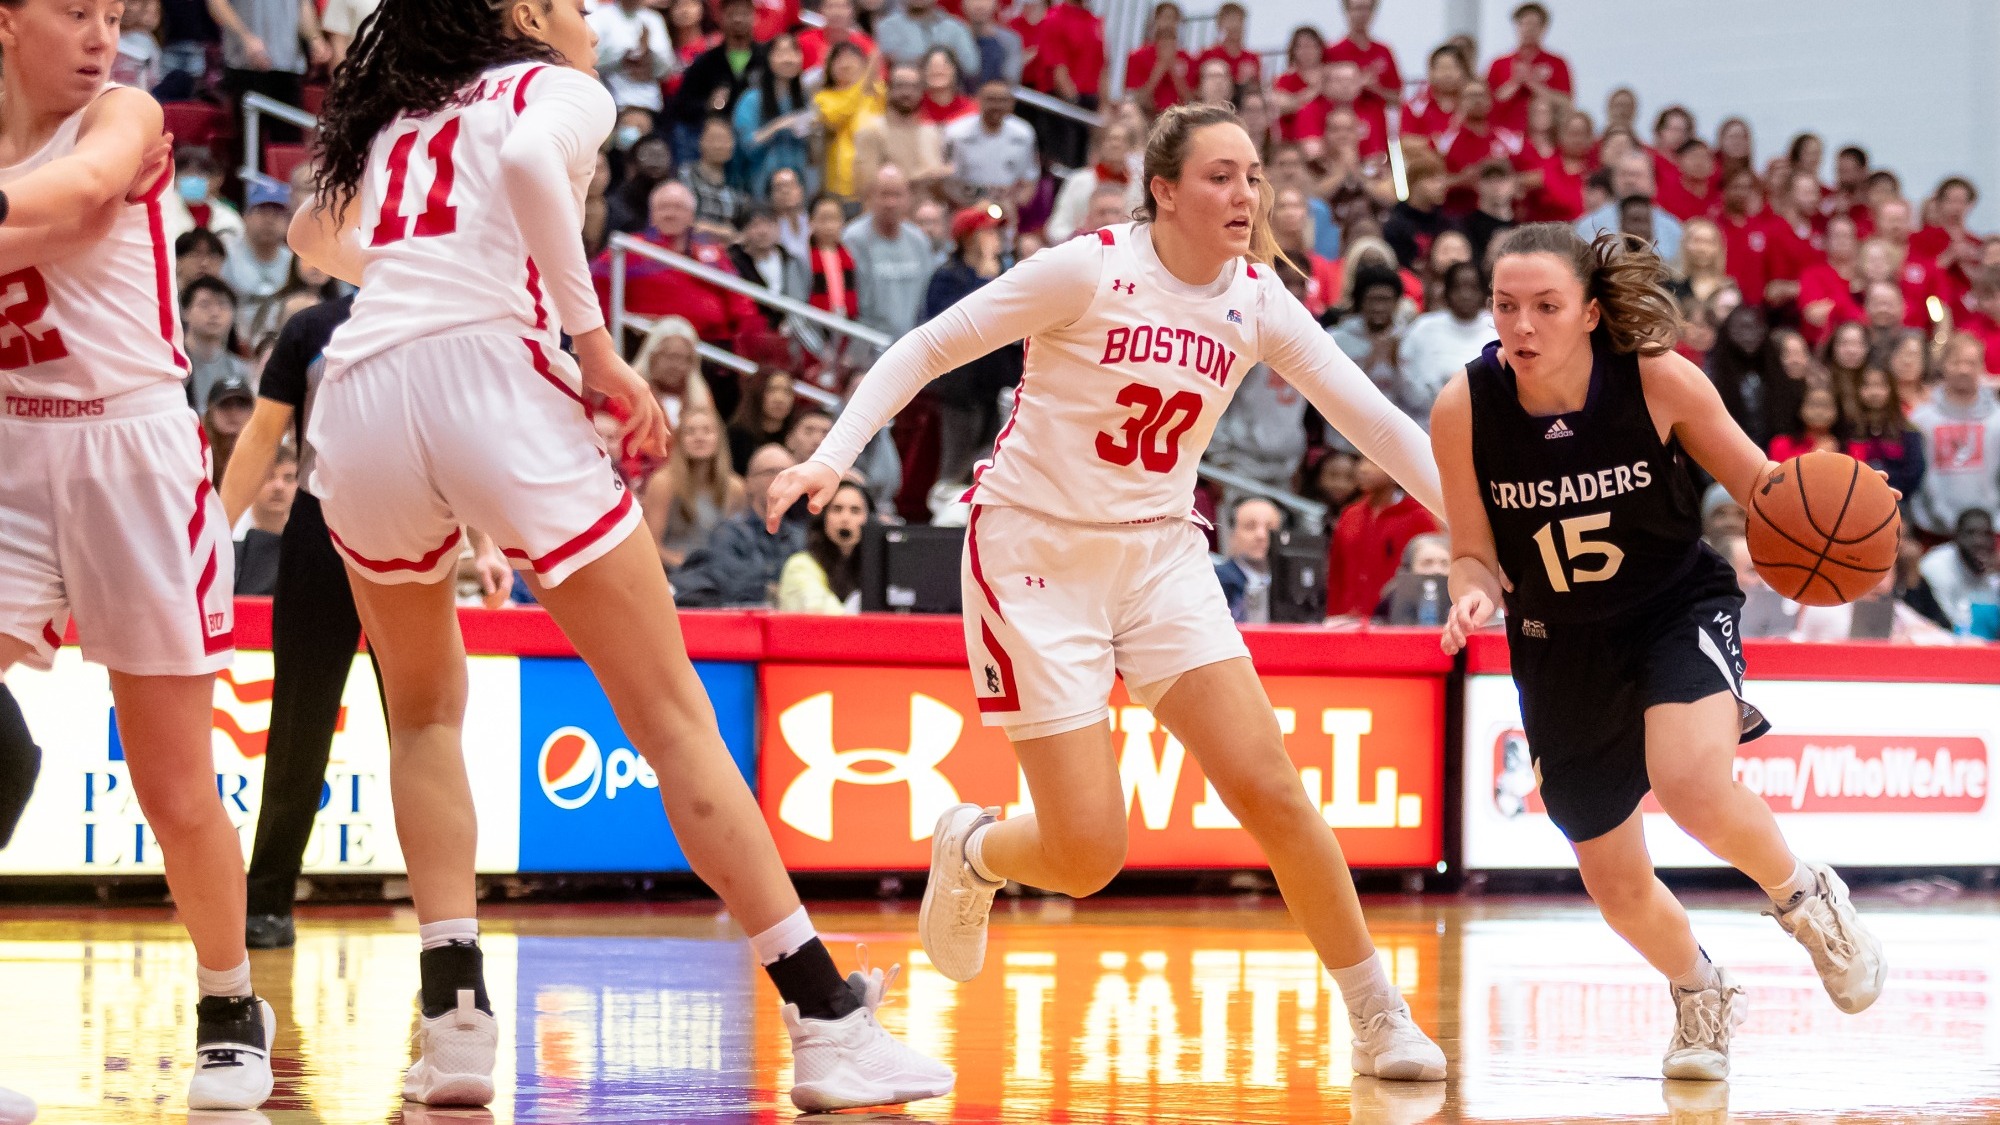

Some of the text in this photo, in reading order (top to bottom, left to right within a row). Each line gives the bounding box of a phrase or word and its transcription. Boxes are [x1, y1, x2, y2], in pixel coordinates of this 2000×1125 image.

[369, 115, 460, 247] 11
[1099, 325, 1237, 387] BOSTON
[6, 396, 105, 418] TERRIERS
[1095, 382, 1203, 473] 30
[1544, 429, 1574, 440] adidas
[1490, 461, 1652, 509] CRUSADERS
[1532, 511, 1625, 592] 15
